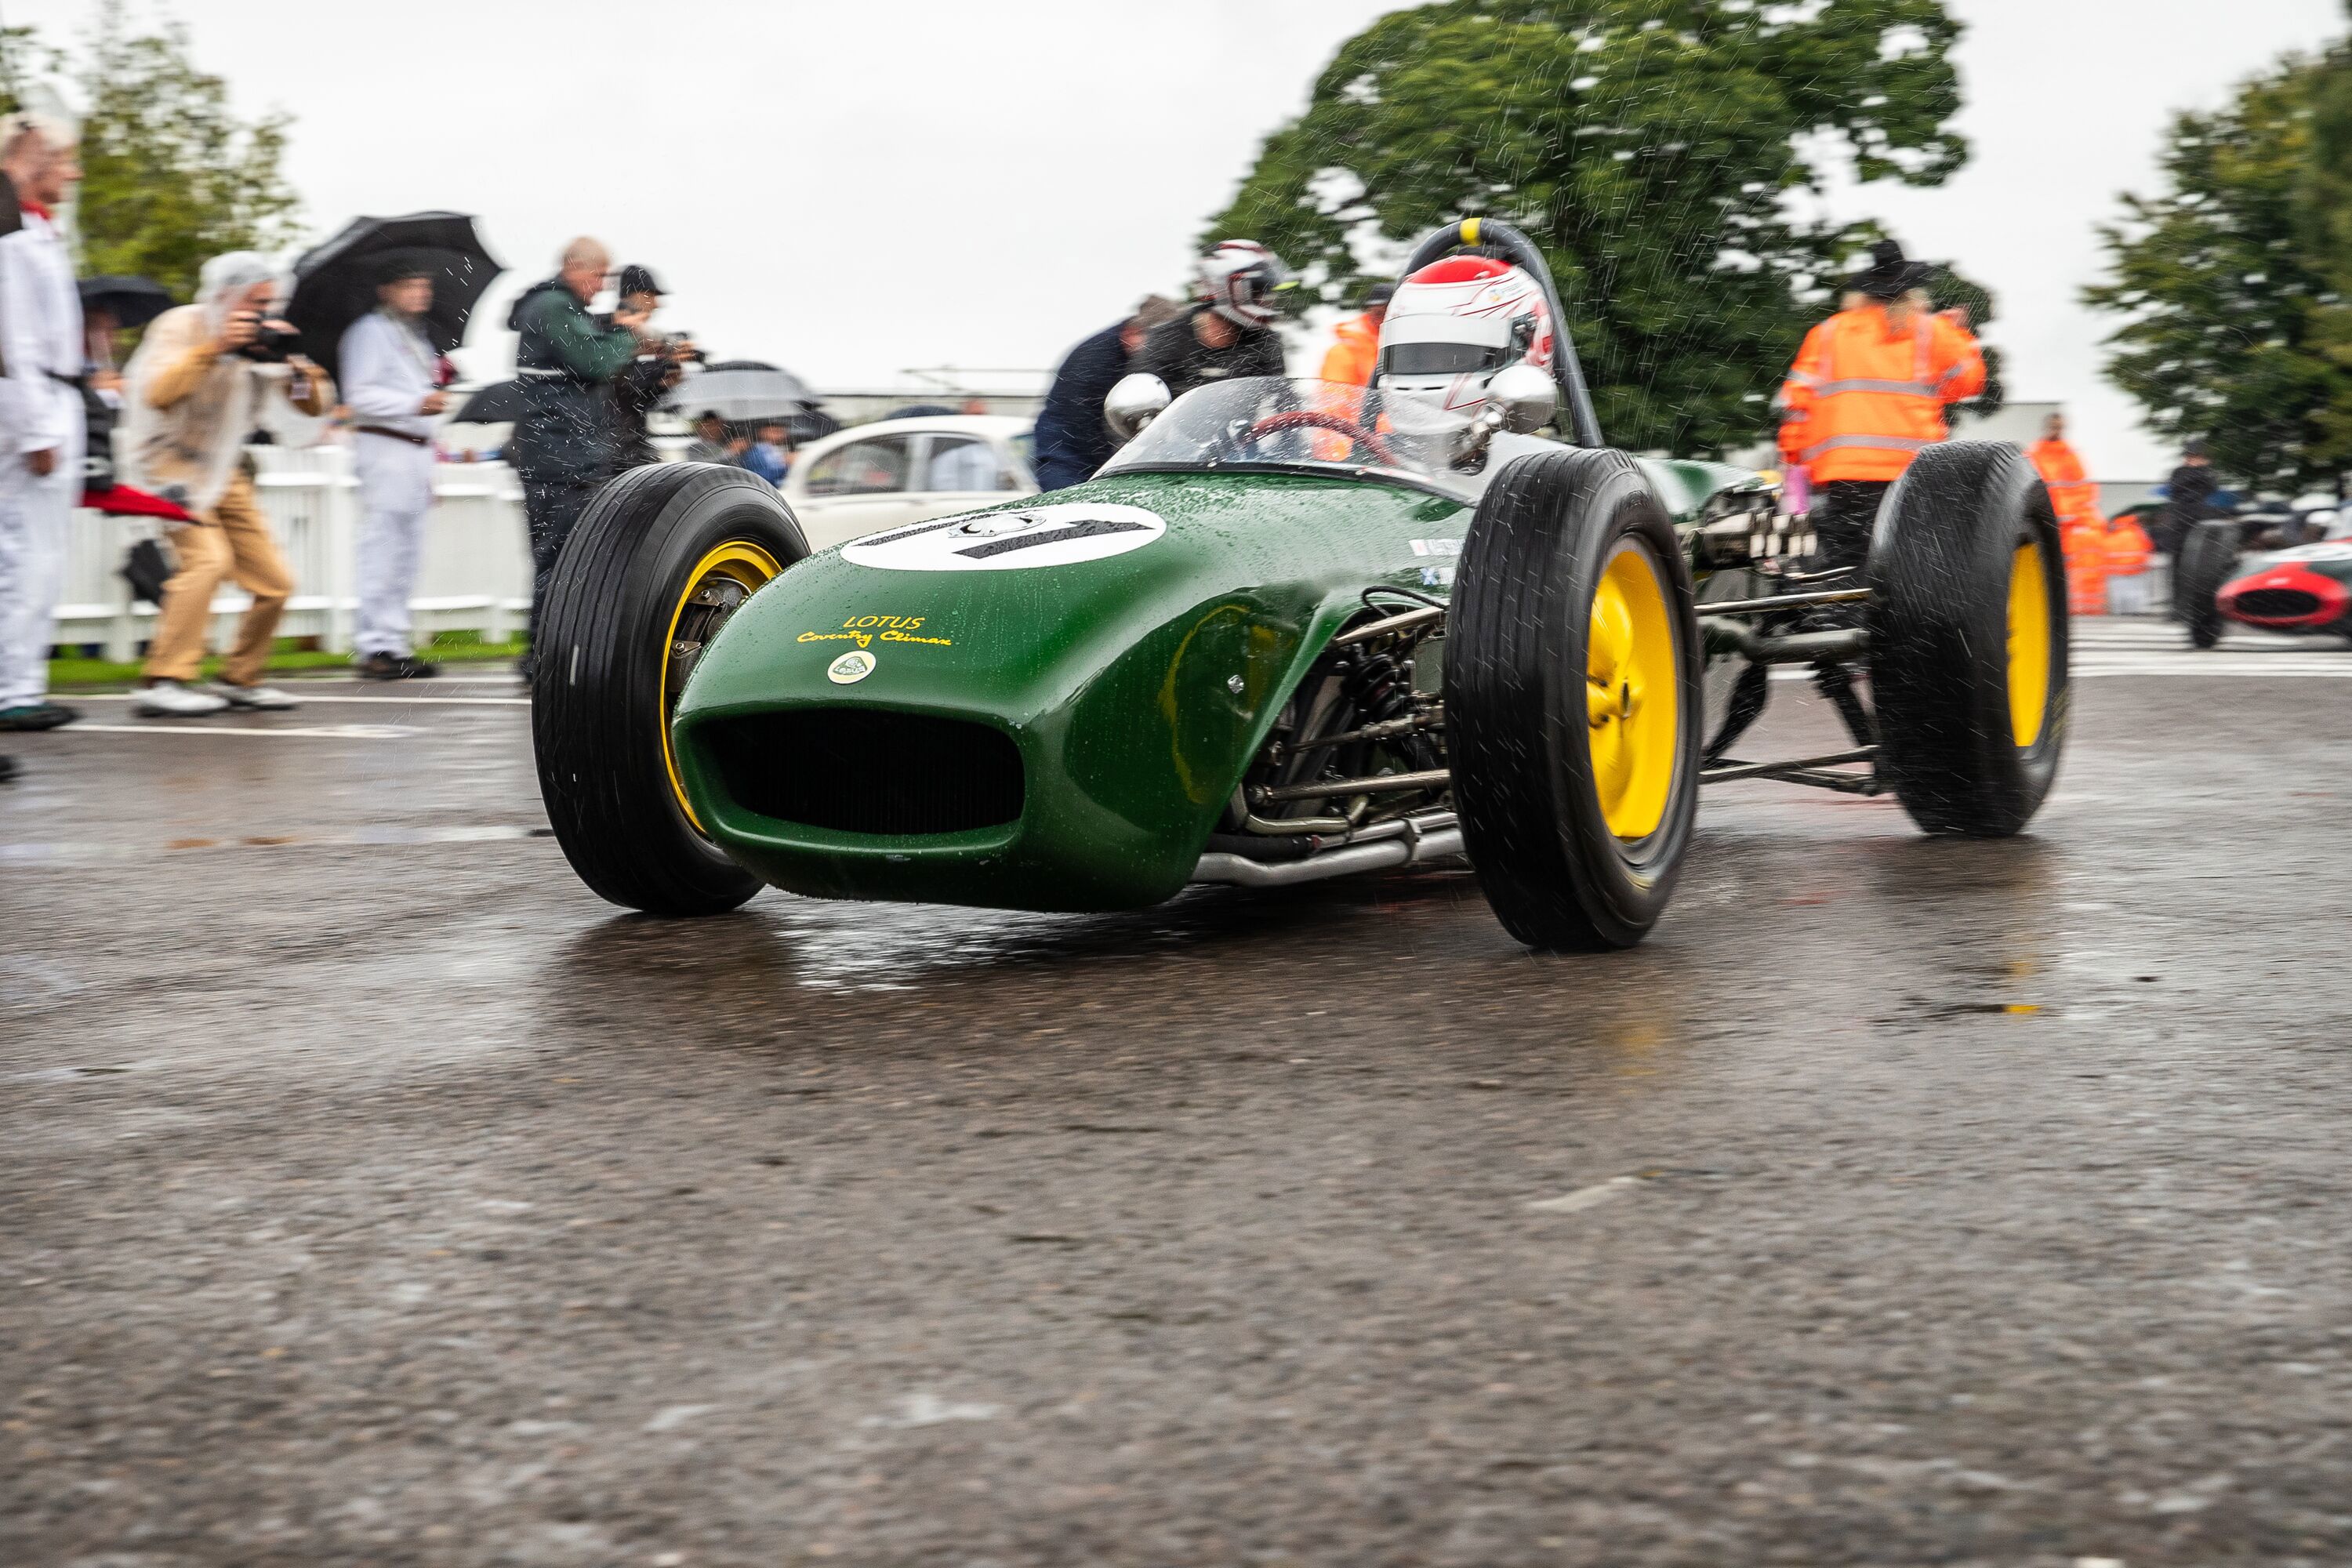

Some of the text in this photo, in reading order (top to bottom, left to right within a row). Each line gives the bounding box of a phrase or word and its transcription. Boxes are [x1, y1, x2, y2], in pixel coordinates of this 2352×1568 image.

[843, 615, 926, 630] LOTUS
[797, 630, 953, 648] Coventry Climax
